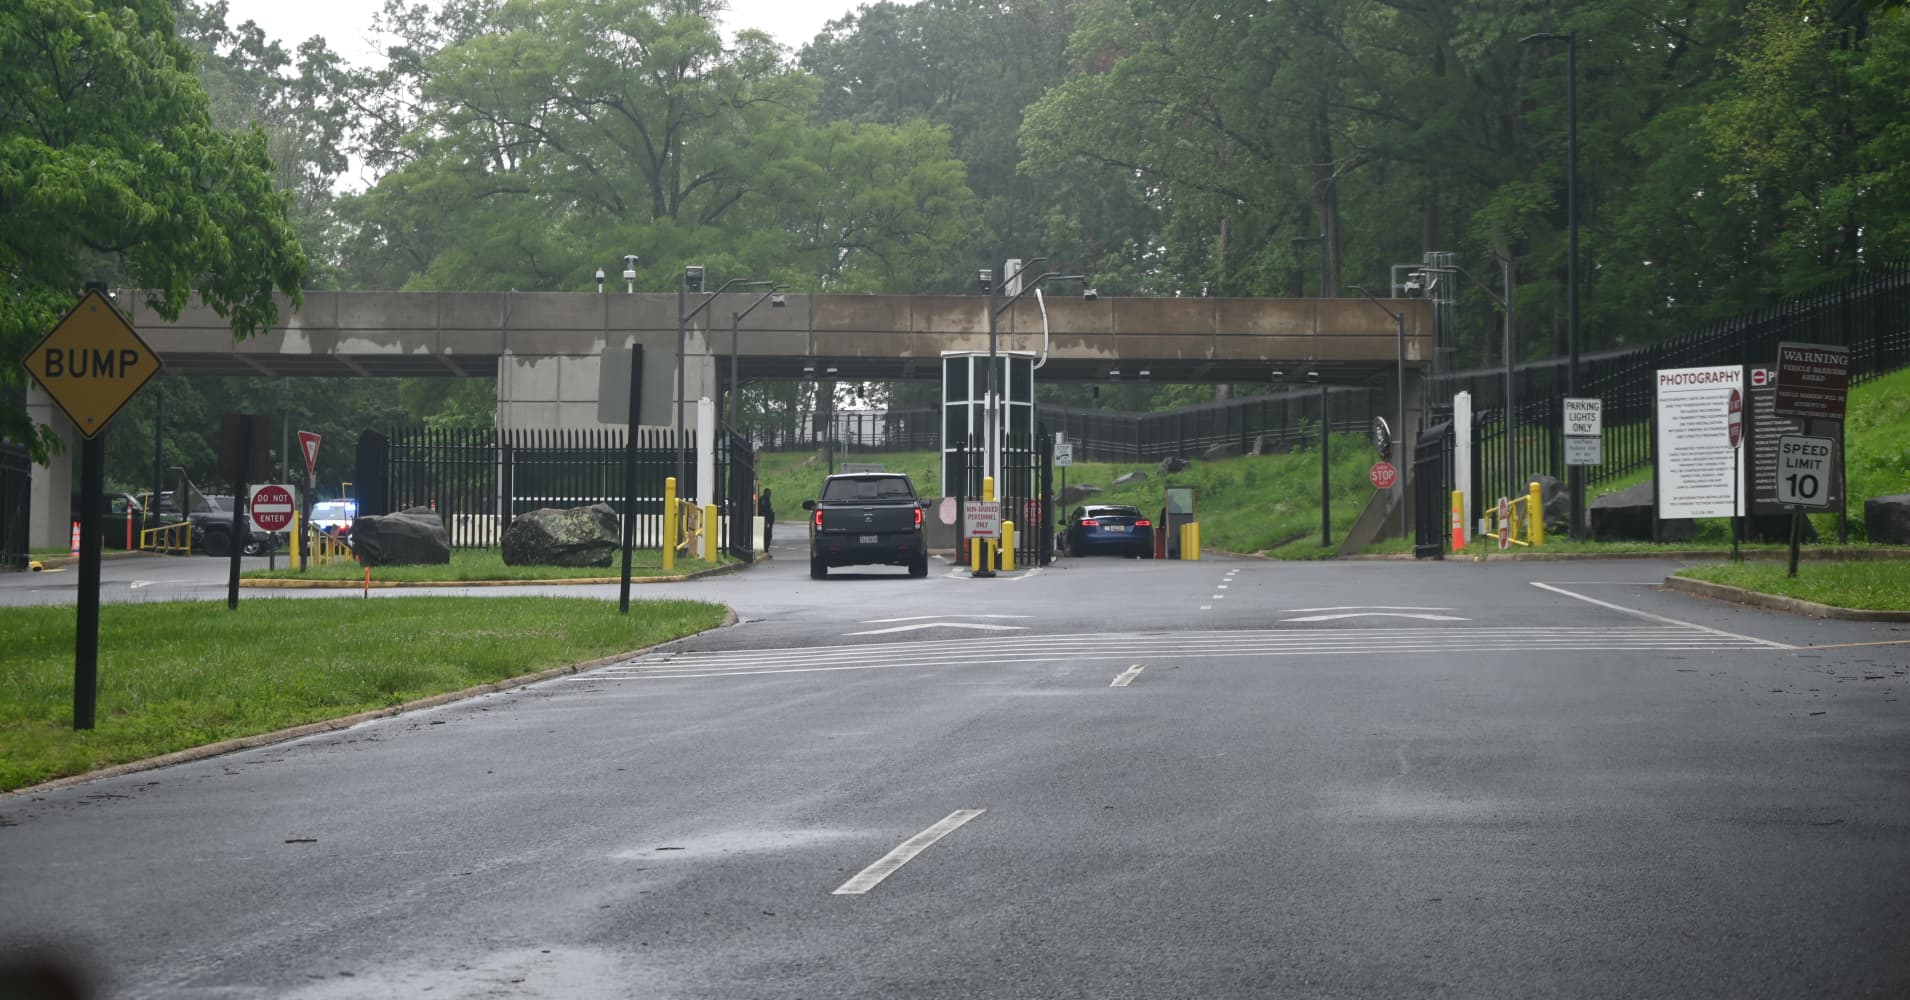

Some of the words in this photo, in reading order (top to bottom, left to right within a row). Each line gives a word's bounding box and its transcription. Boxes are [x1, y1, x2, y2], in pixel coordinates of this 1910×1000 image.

[45, 348, 139, 378] BUMP
[1783, 350, 1848, 366] WARNING
[1660, 370, 1740, 386] PHOTOGRAPHY
[1566, 402, 1599, 411] PARKING
[1569, 413, 1596, 422] LIGHTS
[1573, 423, 1592, 432] ONLY
[1783, 443, 1829, 456] SPEED
[1786, 457, 1822, 470] LIMIT
[1372, 469, 1394, 481] STOP
[1785, 473, 1819, 499] 10
[257, 494, 269, 502] DO
[272, 494, 288, 502] NOT
[260, 514, 285, 523] ENTER
